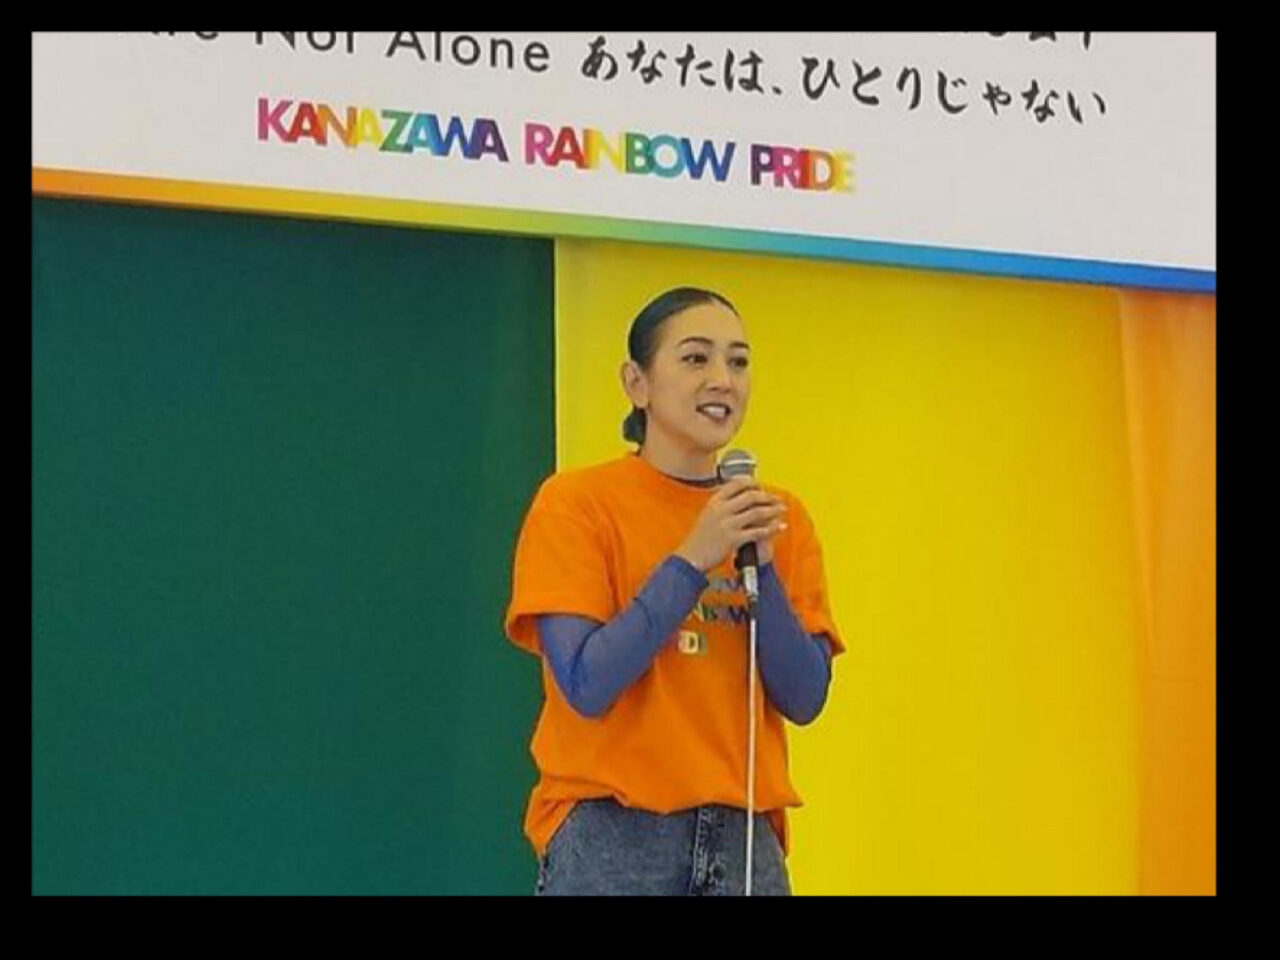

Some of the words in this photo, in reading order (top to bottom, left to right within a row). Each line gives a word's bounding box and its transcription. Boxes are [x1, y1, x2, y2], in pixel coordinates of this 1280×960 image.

[386, 32, 550, 73] Alone
[581, 35, 1107, 124] あなたは、ひとりじゃない
[256, 97, 509, 163] KANAZAWA
[524, 121, 735, 182] RAINBOW
[750, 143, 858, 194] PRIDE
